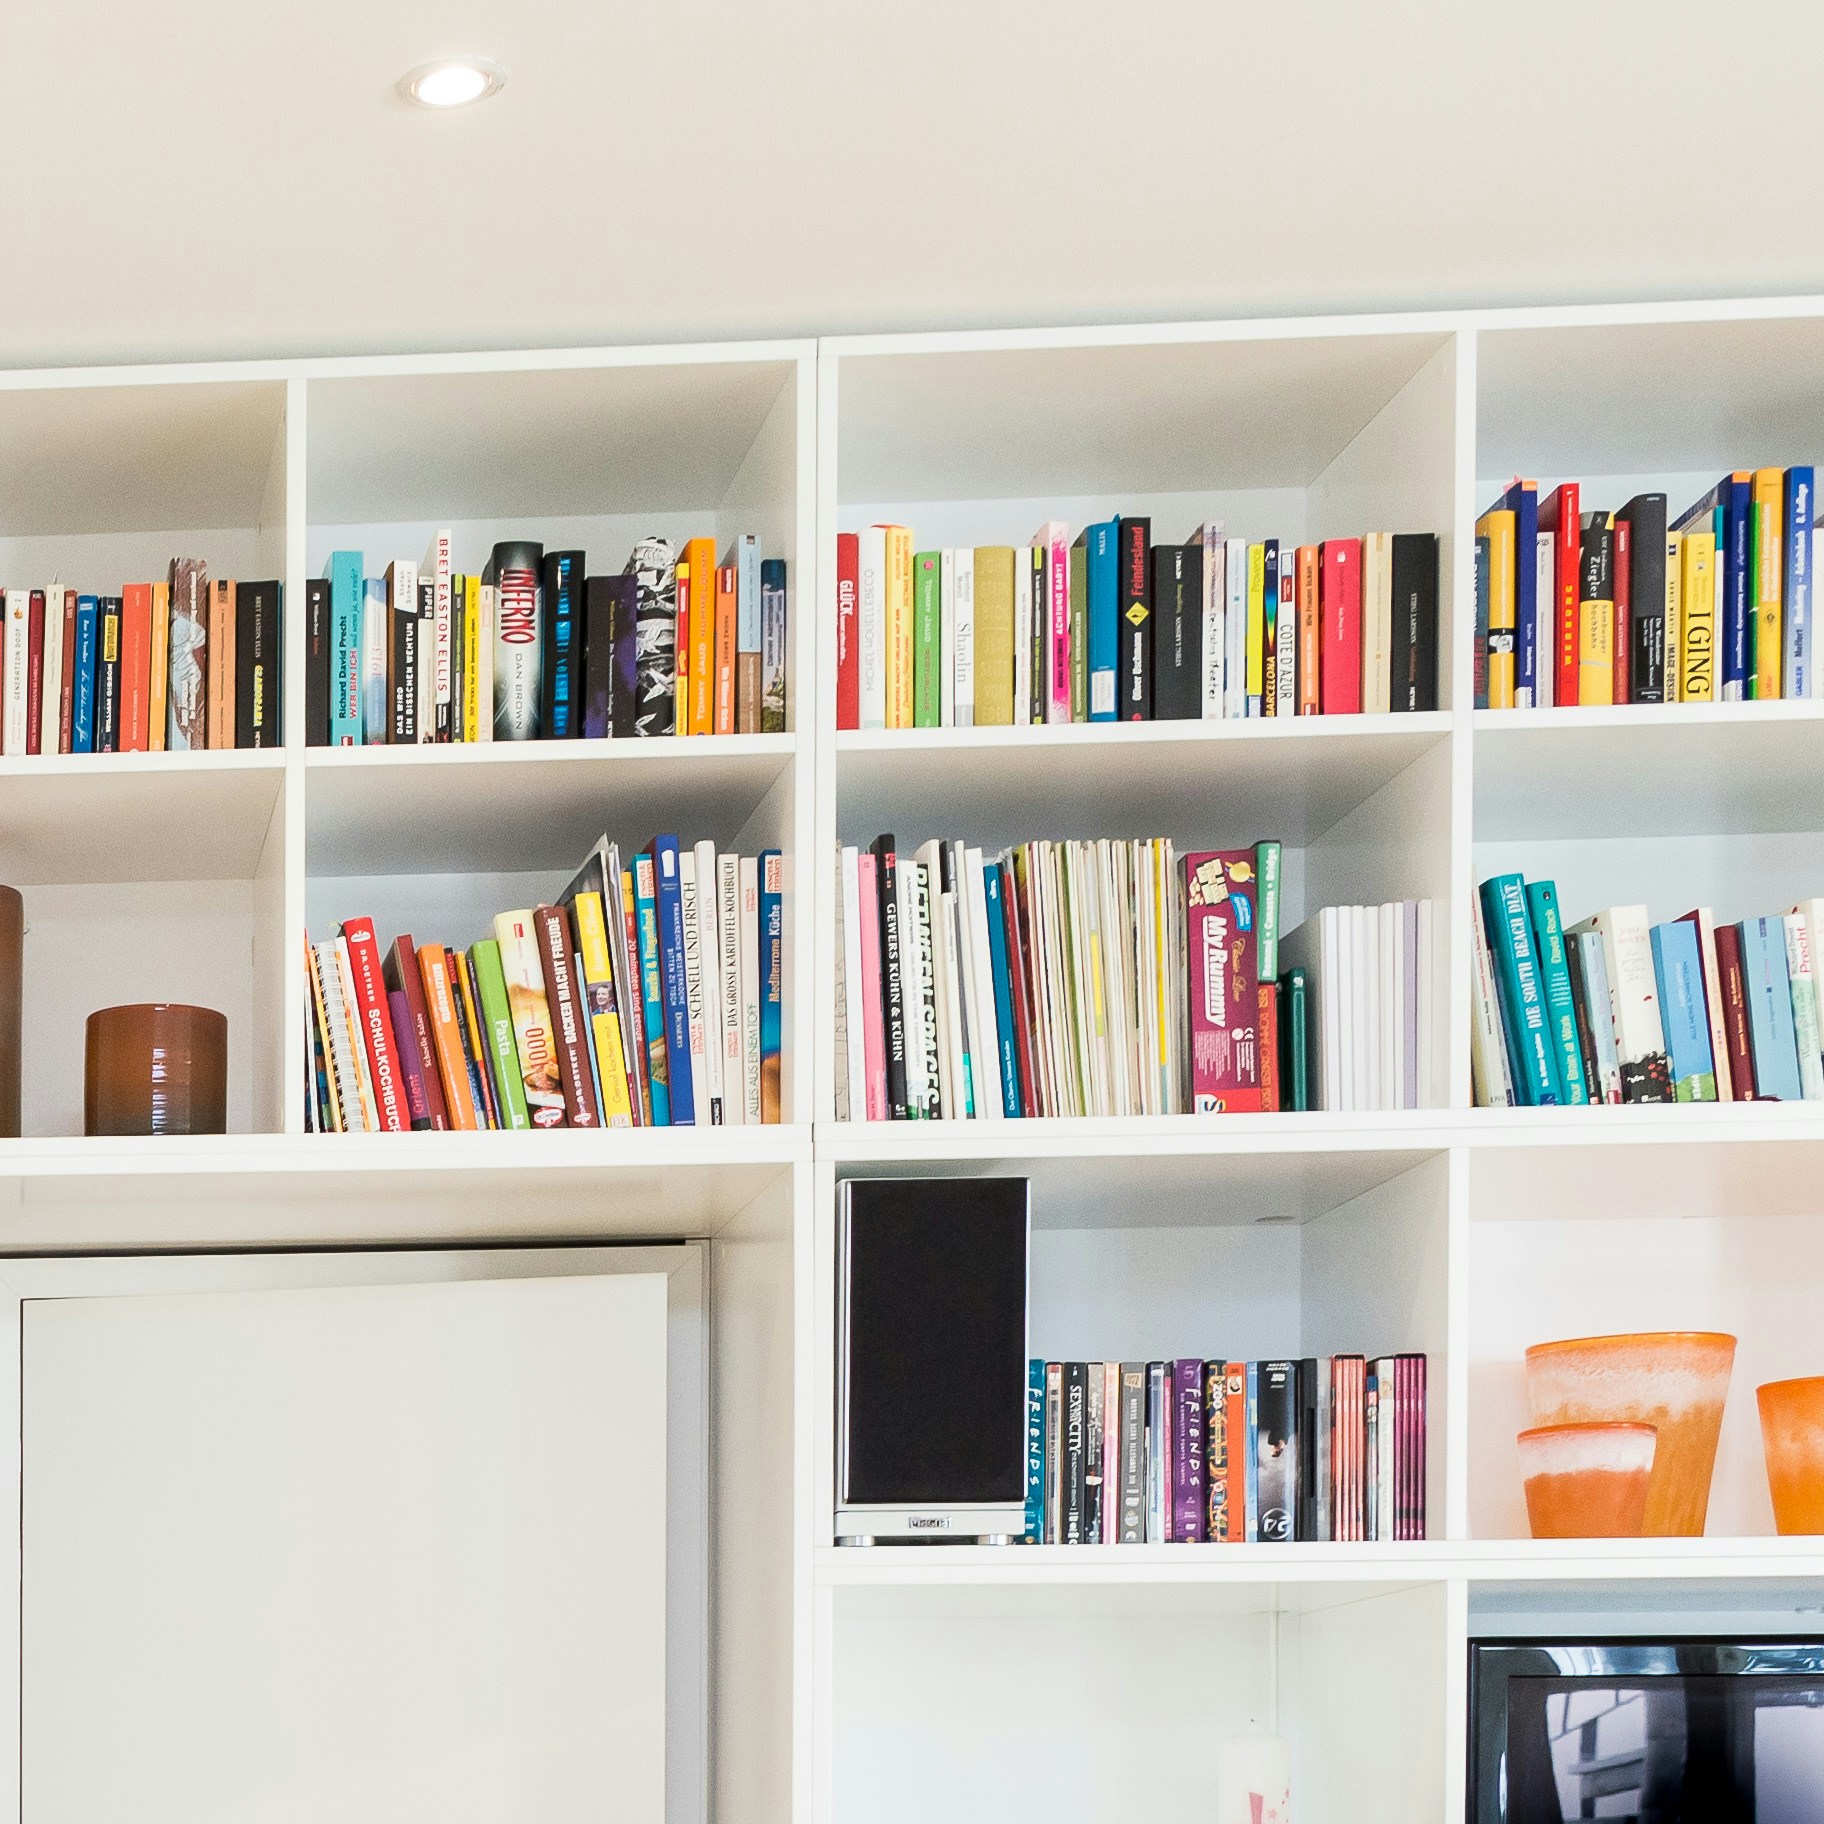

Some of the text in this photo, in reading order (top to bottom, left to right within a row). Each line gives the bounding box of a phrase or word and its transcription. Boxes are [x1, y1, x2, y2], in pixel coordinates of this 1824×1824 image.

[1130, 526, 1144, 596] Feindesland
[1250, 548, 1261, 593] Provence
[1589, 556, 1600, 599] Ziegler
[424, 587, 433, 619] PIPER
[437, 539, 448, 692] BRET EASTON ELLIS
[501, 568, 536, 644] INFERNO
[839, 580, 855, 616] GLÜCK
[924, 579, 933, 643] TOMMY JAUD
[1055, 593, 1064, 635] ACHTUNG
[1565, 585, 1573, 665] WERBUNG
[1590, 604, 1598, 649] hochbahn
[1794, 629, 1803, 658] Meffert
[339, 615, 348, 719] Richard David Precht
[371, 648, 383, 677] 1913
[515, 653, 523, 679] DAN
[865, 651, 875, 692] MICHEL
[957, 623, 971, 683] Shaolin
[1279, 624, 1293, 699] COTE D'AZUR
[1666, 643, 1675, 702] IMAGE-DESIGN
[1686, 626, 1711, 694] GING
[349, 672, 358, 691] BIN
[406, 622, 414, 735] EIN BISSCHEN WEHTUN
[697, 643, 707, 721] TOMMY JAUD
[1208, 660, 1218, 700] Theater
[1266, 656, 1276, 716] BARCELONA
[396, 687, 404, 735] DAS WIRD
[1265, 848, 1277, 881] Bridge
[704, 897, 714, 931] BERLIN
[886, 903, 899, 960] GEWERS
[1545, 908, 1556, 933] Rock
[683, 882, 702, 1019] SCHNELL UND FRISCH
[723, 862, 738, 1027] DAS GROSSE KARTOFFEL-KOCHBUCH
[767, 904, 780, 1003] Mediterrane Küche
[1510, 917, 1530, 958] BEACH
[1796, 927, 1811, 973] Precht
[362, 965, 375, 1002] OETKER
[552, 916, 576, 1043] BACKEN MACHT FREUDE
[628, 938, 641, 1012] 20 minuten sind
[889, 962, 902, 1003] KÜHN
[1519, 962, 1537, 1003] SOUTH
[495, 1019, 510, 1056] Pasta
[1525, 1005, 1543, 1029] DIE
[525, 1027, 549, 1069] 1000
[747, 1002, 759, 1117] ALLES AUS EINEM TOPF
[891, 1023, 904, 1061] KÜHN
[1560, 1015, 1579, 1080] Brain at Work
[409, 1074, 424, 1113] Orient
[1070, 1385, 1082, 1408] SEX
[1029, 1388, 1042, 1486] FRIENDS
[1069, 1422, 1081, 1454] CITY
[1185, 1388, 1201, 1486] FRIENDS
